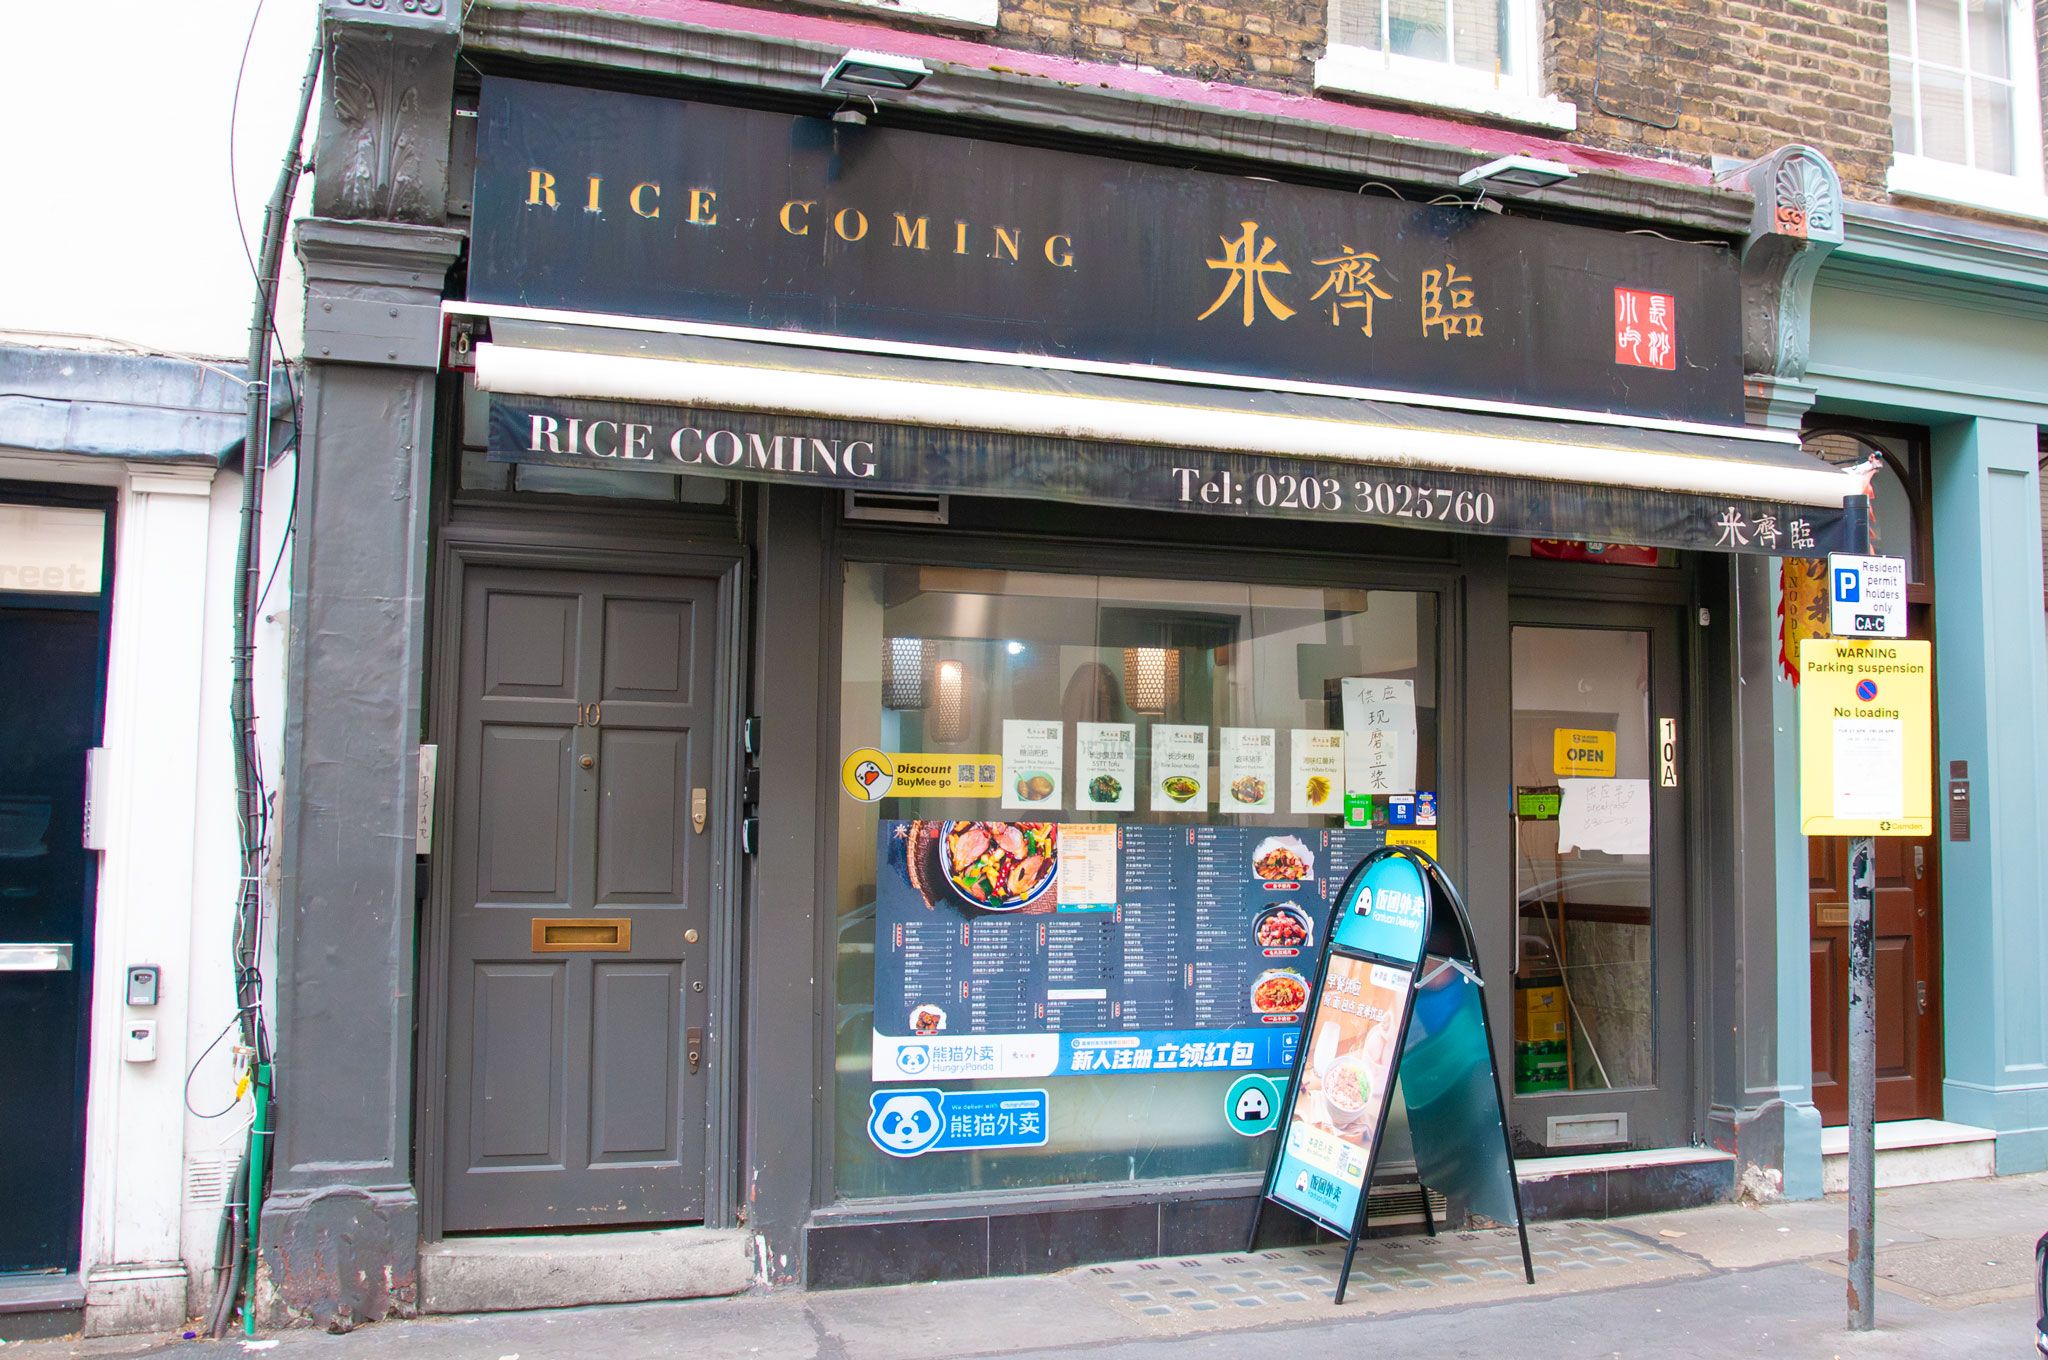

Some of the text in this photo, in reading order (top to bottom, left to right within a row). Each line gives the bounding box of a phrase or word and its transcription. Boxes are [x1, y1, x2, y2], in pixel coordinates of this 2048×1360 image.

[526, 168, 1076, 268] RICE COMING
[1197, 220, 1485, 342] 米齊臨
[527, 412, 878, 479] RICE COMING
[1171, 466, 1496, 526] Tel: 0203 3025760
[1714, 505, 1816, 551] 米齊臨
[1862, 561, 1902, 574] Resident
[1840, 571, 1857, 600] P
[1867, 576, 1898, 587] permit
[1865, 588, 1900, 600] holders
[1873, 602, 1893, 614] only
[1836, 647, 1897, 659] WARNING
[1808, 661, 1924, 675] Parking suspension
[1358, 685, 1398, 704] 供应
[576, 702, 601, 728] 10
[1834, 707, 1900, 719] No loading
[1367, 709, 1391, 790] 现磨豆浆
[1566, 748, 1604, 763] OPEN
[1663, 720, 1676, 786] 10A
[896, 763, 952, 775] Discount
[896, 777, 951, 788] BuyMee go
[932, 1045, 994, 1062] 熊猫外卖
[1070, 1041, 1255, 1072] 新人注册立领红包
[932, 1062, 994, 1073] HungryPanda
[951, 1111, 1040, 1138] 熊猫外卖
